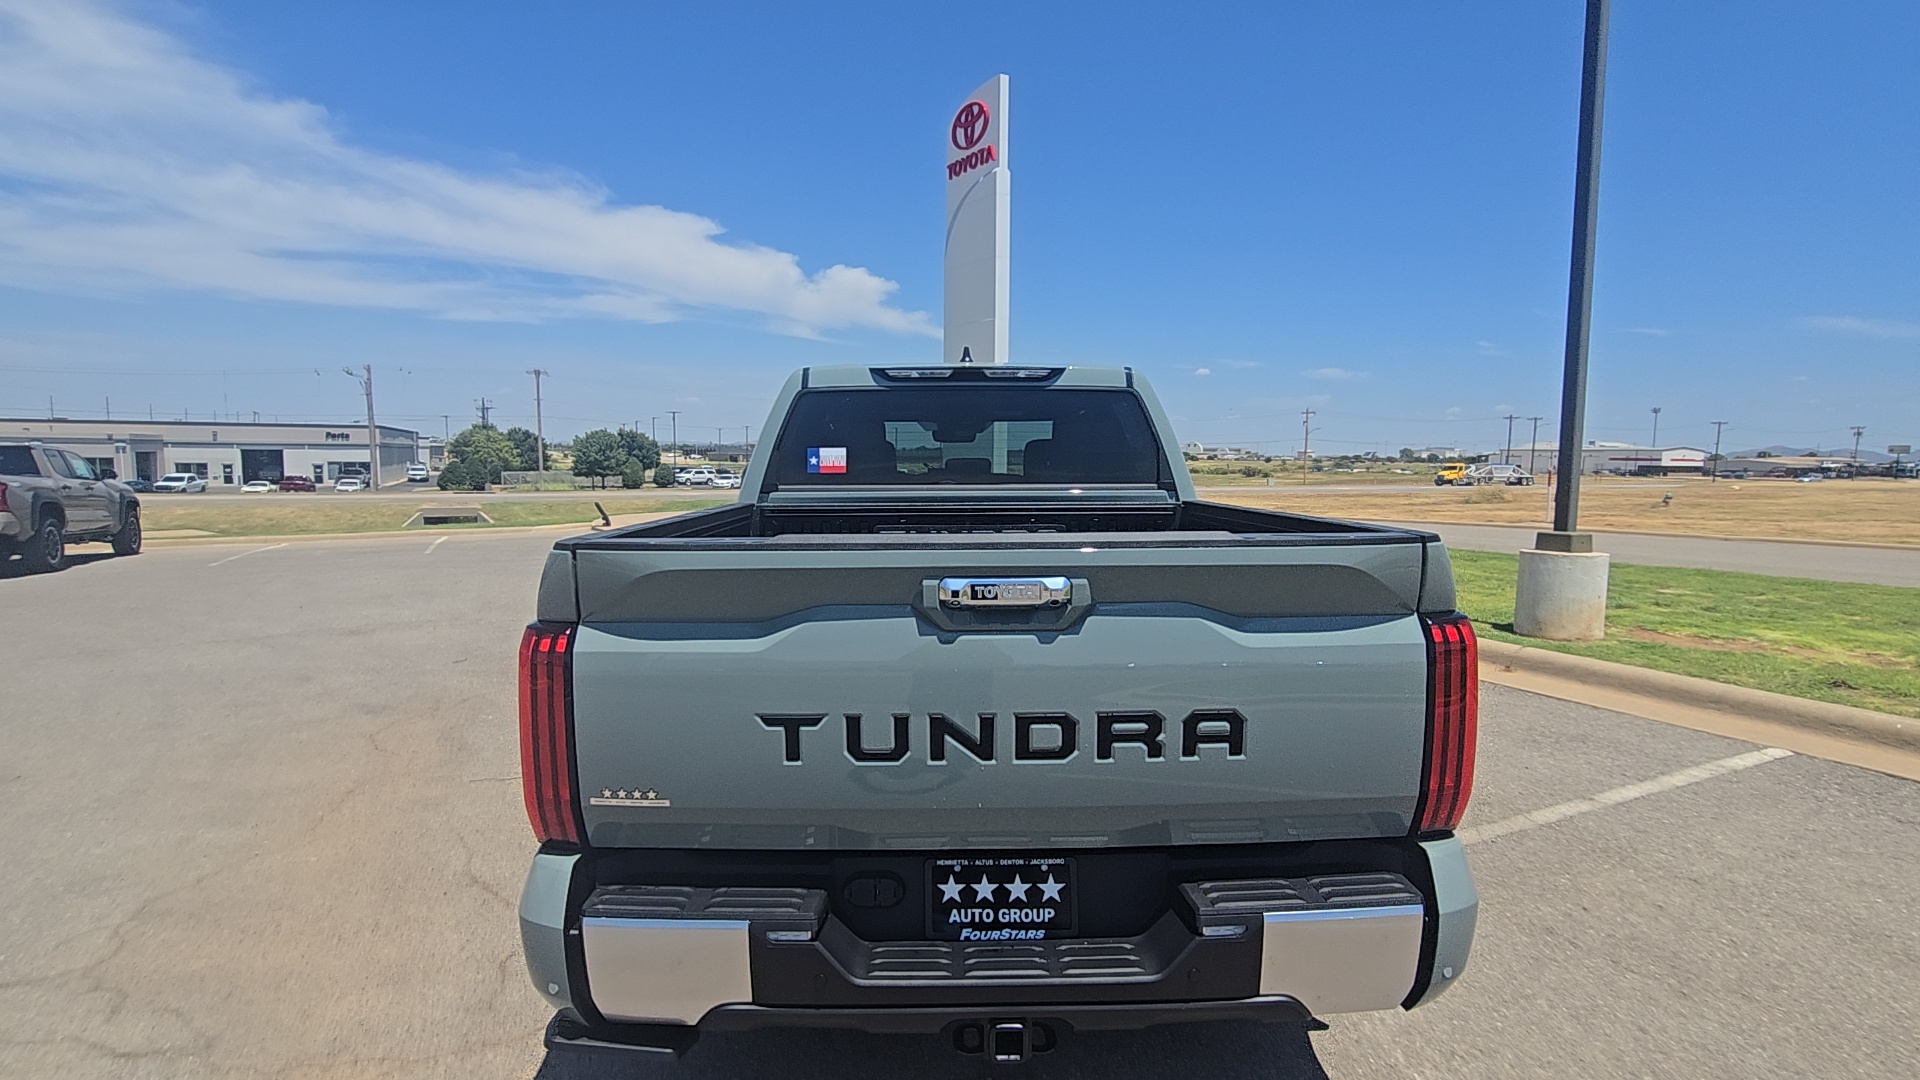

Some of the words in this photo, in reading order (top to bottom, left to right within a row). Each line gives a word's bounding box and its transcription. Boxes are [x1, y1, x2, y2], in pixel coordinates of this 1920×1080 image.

[947, 144, 997, 181] TOYOTA
[325, 431, 350, 441] Parts
[974, 585, 1036, 599] TOYOTA
[754, 708, 1249, 765] TUNDRA
[949, 908, 994, 923] AUTO
[998, 908, 1056, 923] GROUP
